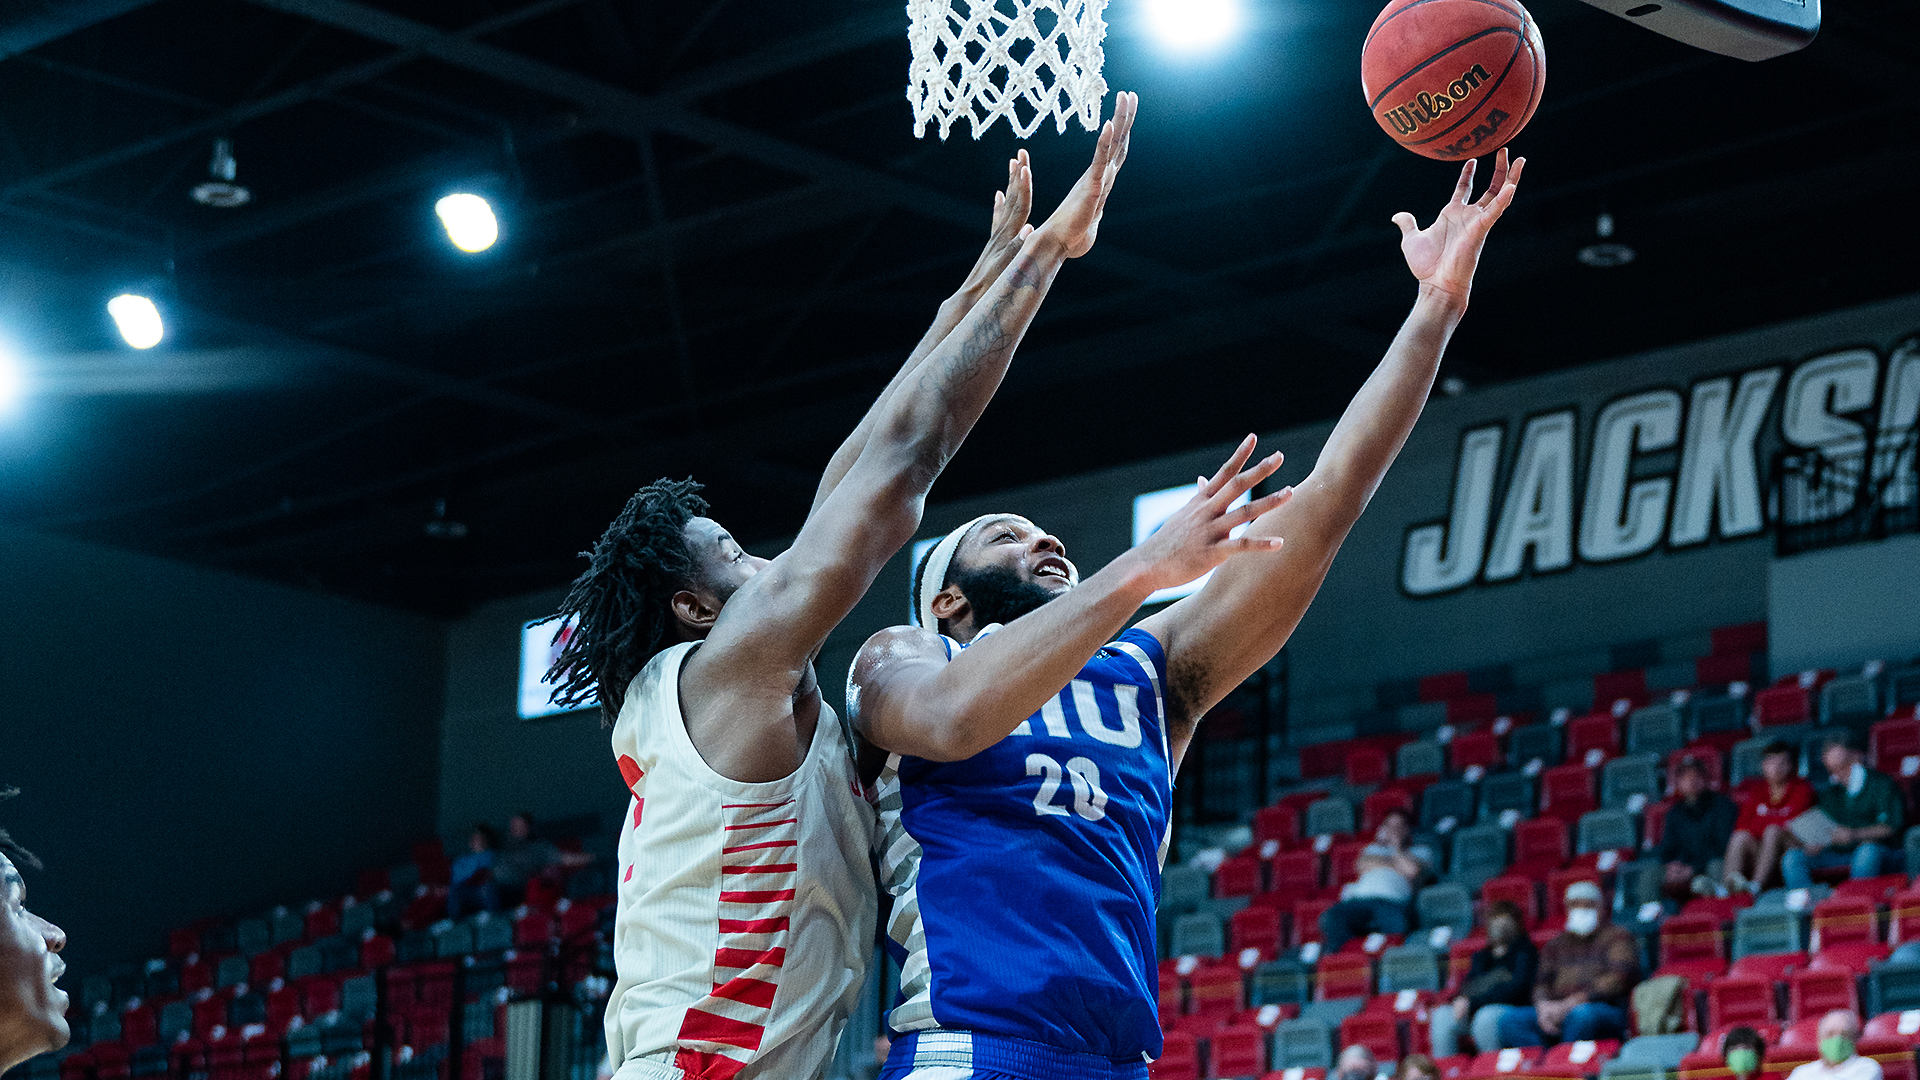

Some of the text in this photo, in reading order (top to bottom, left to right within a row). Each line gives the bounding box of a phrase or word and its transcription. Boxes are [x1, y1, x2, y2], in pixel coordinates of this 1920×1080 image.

[1383, 63, 1493, 136] Wilson
[1433, 107, 1511, 158] NCAA
[1009, 678, 1143, 749] IU
[1025, 753, 1109, 821] 20
